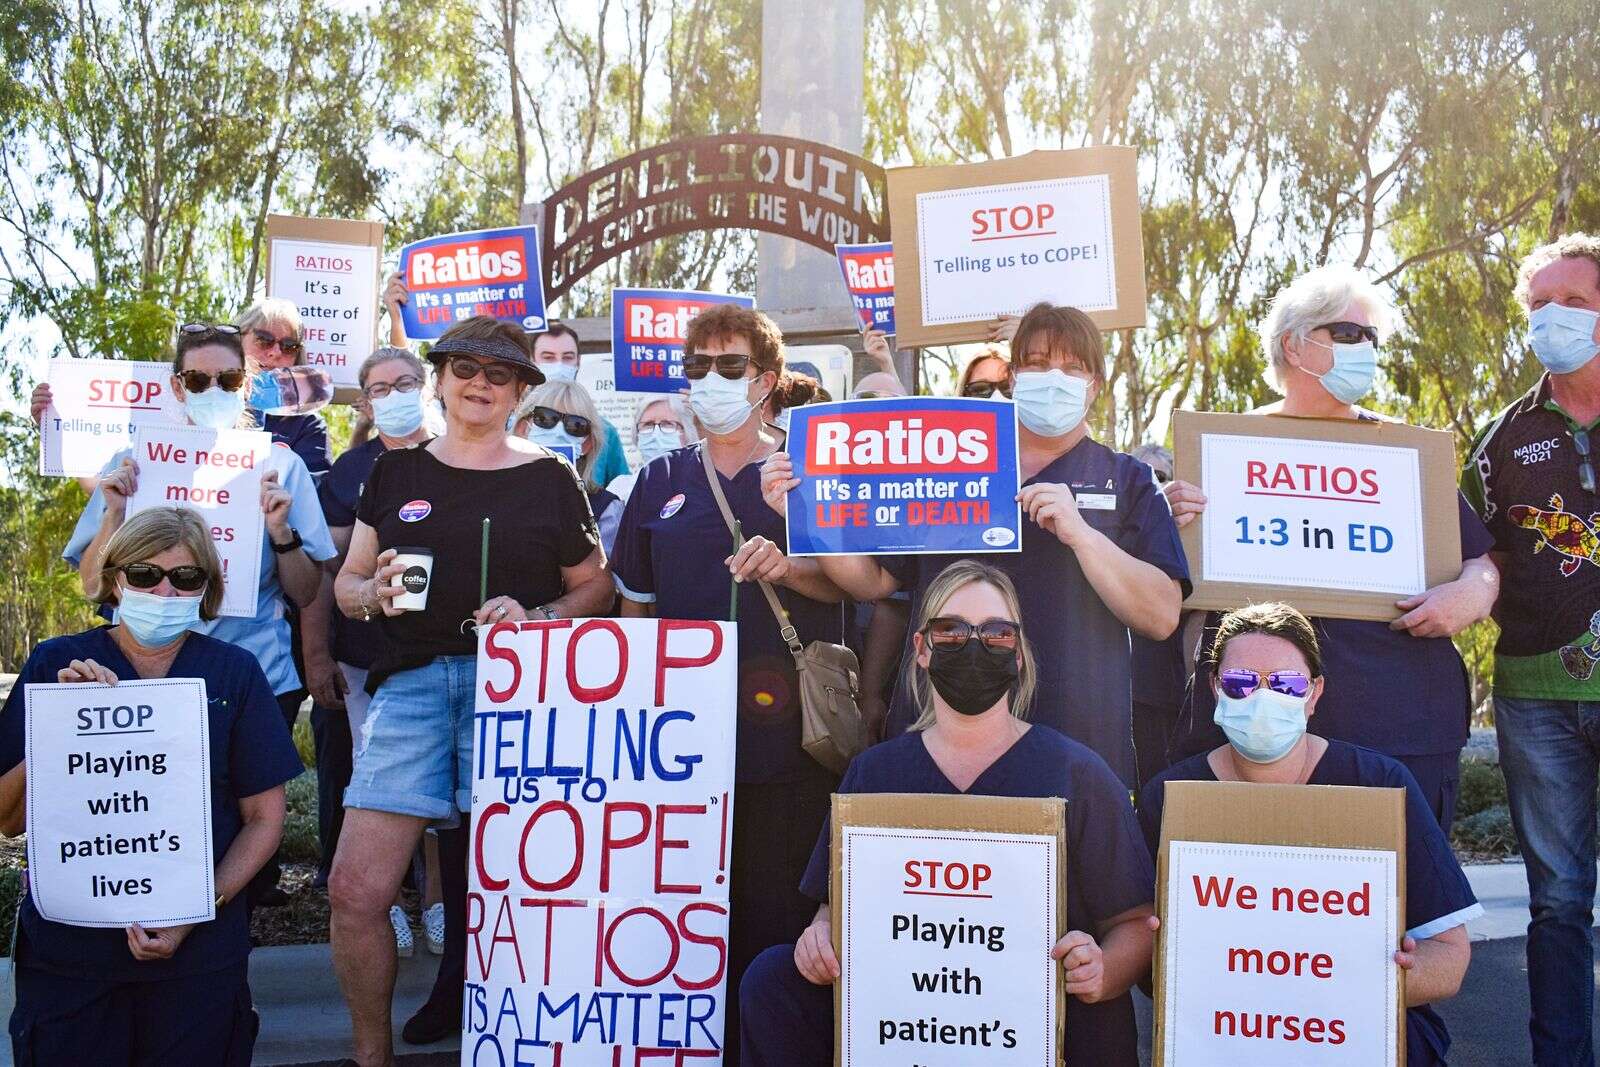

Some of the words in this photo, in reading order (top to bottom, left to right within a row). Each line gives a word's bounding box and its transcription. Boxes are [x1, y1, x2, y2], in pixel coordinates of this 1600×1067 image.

[553, 143, 883, 249] DENILIQUIN
[708, 192, 736, 218] OF
[746, 192, 787, 226] THE
[971, 203, 1055, 235] STOP
[295, 255, 353, 272] RATIOS
[411, 246, 522, 285] Ratios
[845, 256, 894, 289] Rati
[934, 254, 991, 274] Telling
[996, 255, 1015, 268] us
[1020, 252, 1039, 266] to
[1044, 244, 1098, 264] COPE!
[305, 280, 328, 294] It's
[333, 285, 341, 295] a
[416, 292, 439, 307] It's
[442, 293, 453, 305] a
[456, 286, 505, 304] matter
[509, 283, 525, 299] of
[297, 306, 338, 319] atter
[343, 307, 360, 320] of
[417, 306, 451, 324] LIFE
[456, 306, 471, 318] or
[866, 297, 873, 308] a
[875, 310, 889, 321] or
[304, 328, 326, 342] IFE
[330, 332, 347, 342] or
[307, 352, 346, 366] EATH
[631, 345, 653, 361] It's
[657, 349, 667, 361] a
[631, 361, 664, 378] LIFE
[667, 364, 684, 377] or
[88, 379, 162, 404] STOP
[53, 418, 101, 436] Telling
[106, 423, 122, 434] us
[147, 441, 187, 464] We
[195, 450, 255, 469] need
[815, 418, 988, 466] Ratios
[1513, 438, 1560, 459] NAIDOC
[1522, 450, 1551, 465] 2021
[815, 478, 850, 501] It's
[857, 483, 872, 501] a
[879, 479, 959, 499] matter
[965, 476, 989, 498] of
[1247, 460, 1379, 497] RATIOS
[166, 485, 230, 504] more
[816, 502, 868, 528] LIFE
[875, 504, 900, 524] or
[907, 500, 990, 526] DEATH
[1235, 516, 1289, 546] 1:3
[1302, 519, 1334, 549] in
[1348, 524, 1394, 553] ED
[485, 618, 723, 707] STOP
[77, 704, 154, 731] STOP
[475, 704, 702, 782] TELLING
[68, 750, 167, 777] Playing
[88, 790, 149, 815] with
[503, 777, 540, 804] US
[557, 777, 607, 802] TO
[60, 830, 180, 863] patient's
[92, 876, 153, 898] lives
[904, 860, 992, 890] STOP
[1192, 875, 1257, 910] We
[1272, 882, 1370, 916] need
[464, 892, 727, 990] RATIOS
[892, 914, 1005, 952] Playing
[1228, 947, 1333, 978] more
[912, 967, 982, 995] with
[495, 987, 523, 1039] A
[536, 991, 721, 1050] MATTER
[1214, 1010, 1346, 1045] nurses
[879, 1017, 1017, 1049] patient's
